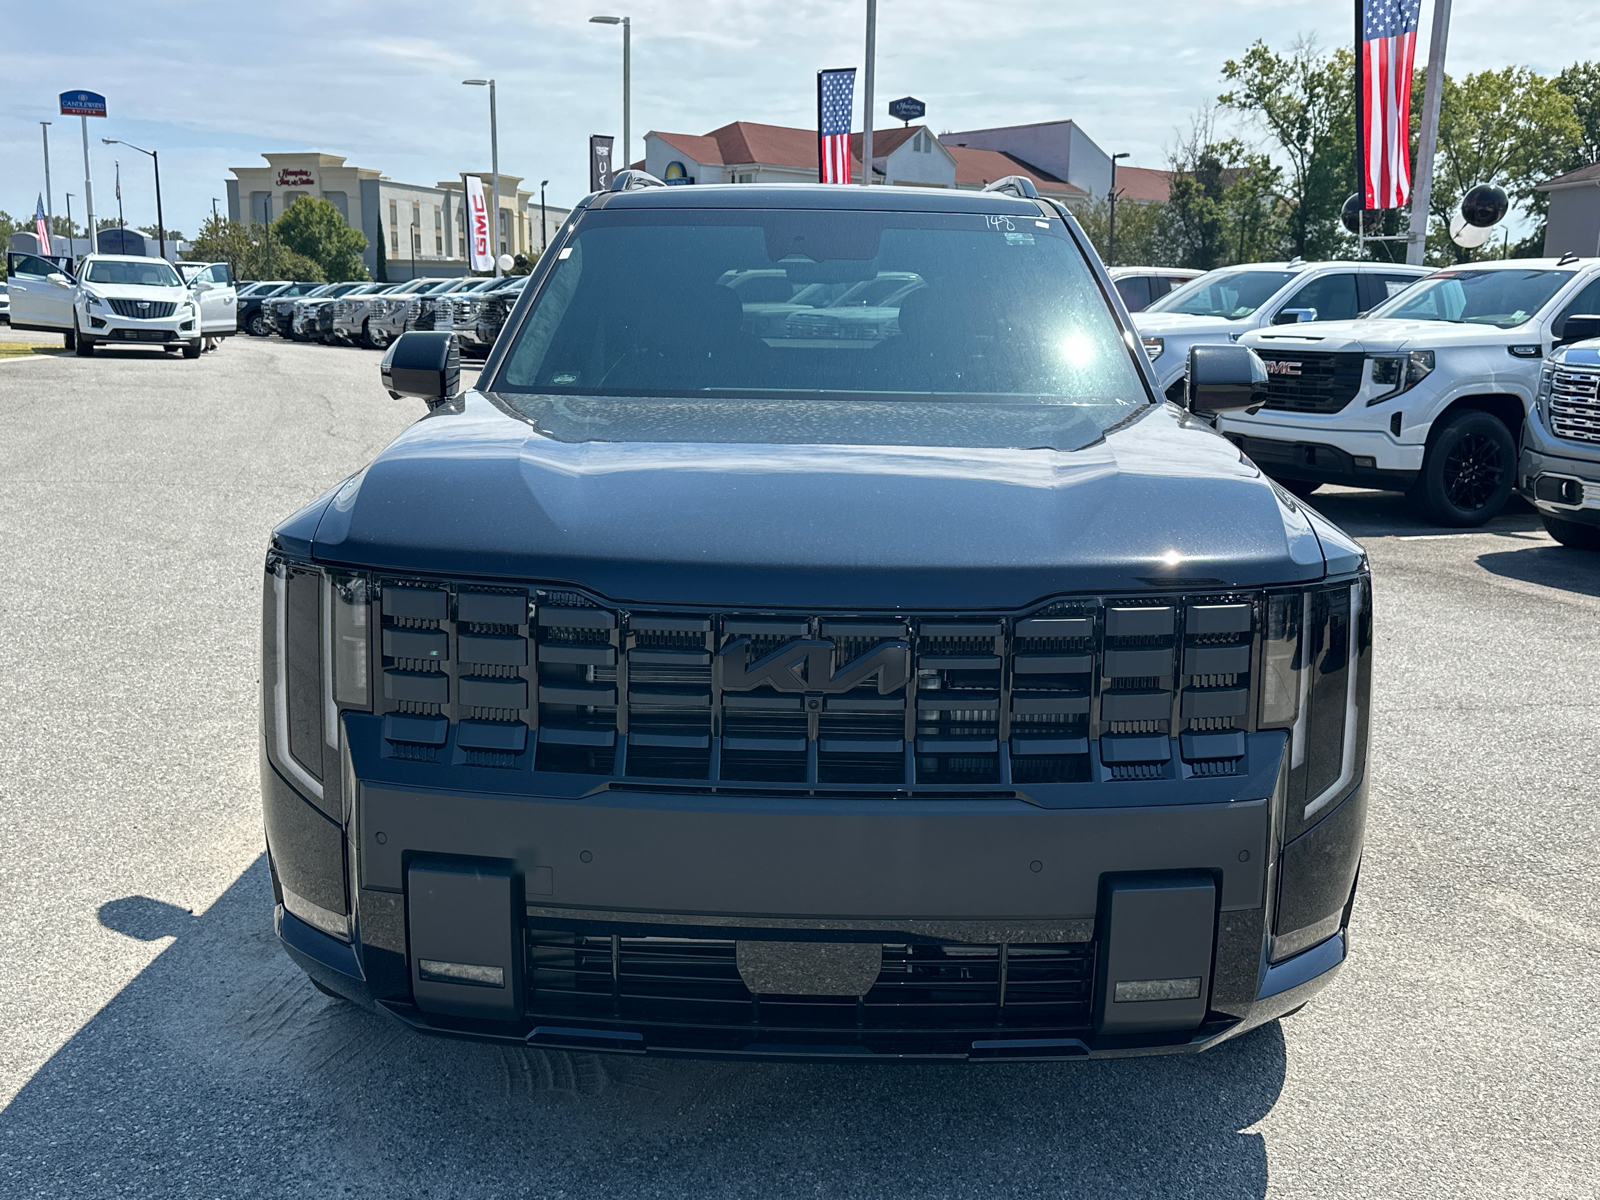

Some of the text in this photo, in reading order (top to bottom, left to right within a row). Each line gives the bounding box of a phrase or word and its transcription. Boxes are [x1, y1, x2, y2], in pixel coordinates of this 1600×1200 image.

[62, 100, 105, 109] CANDLEWOOD
[277, 167, 312, 178] Hampton
[598, 161, 606, 190] AC
[471, 194, 487, 256] GMC
[984, 214, 1016, 231] 148
[719, 637, 911, 696] KIA
